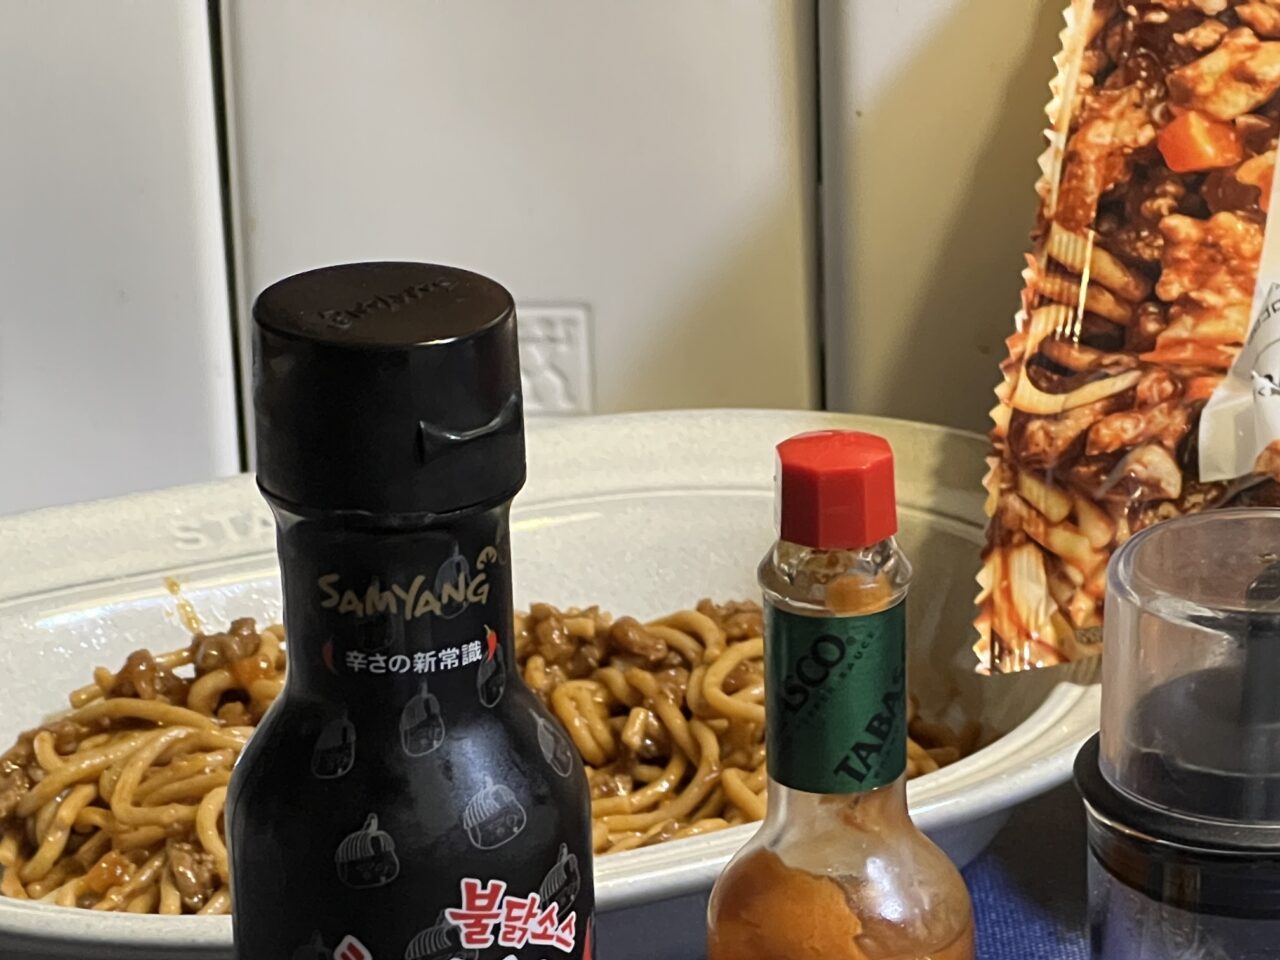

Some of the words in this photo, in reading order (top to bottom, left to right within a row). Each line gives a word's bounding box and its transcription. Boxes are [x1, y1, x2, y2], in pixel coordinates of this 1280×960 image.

[318, 573, 490, 620] SAMYANG
[345, 641, 482, 673] 辛さの新常識
[446, 878, 576, 952] 불닭소스
